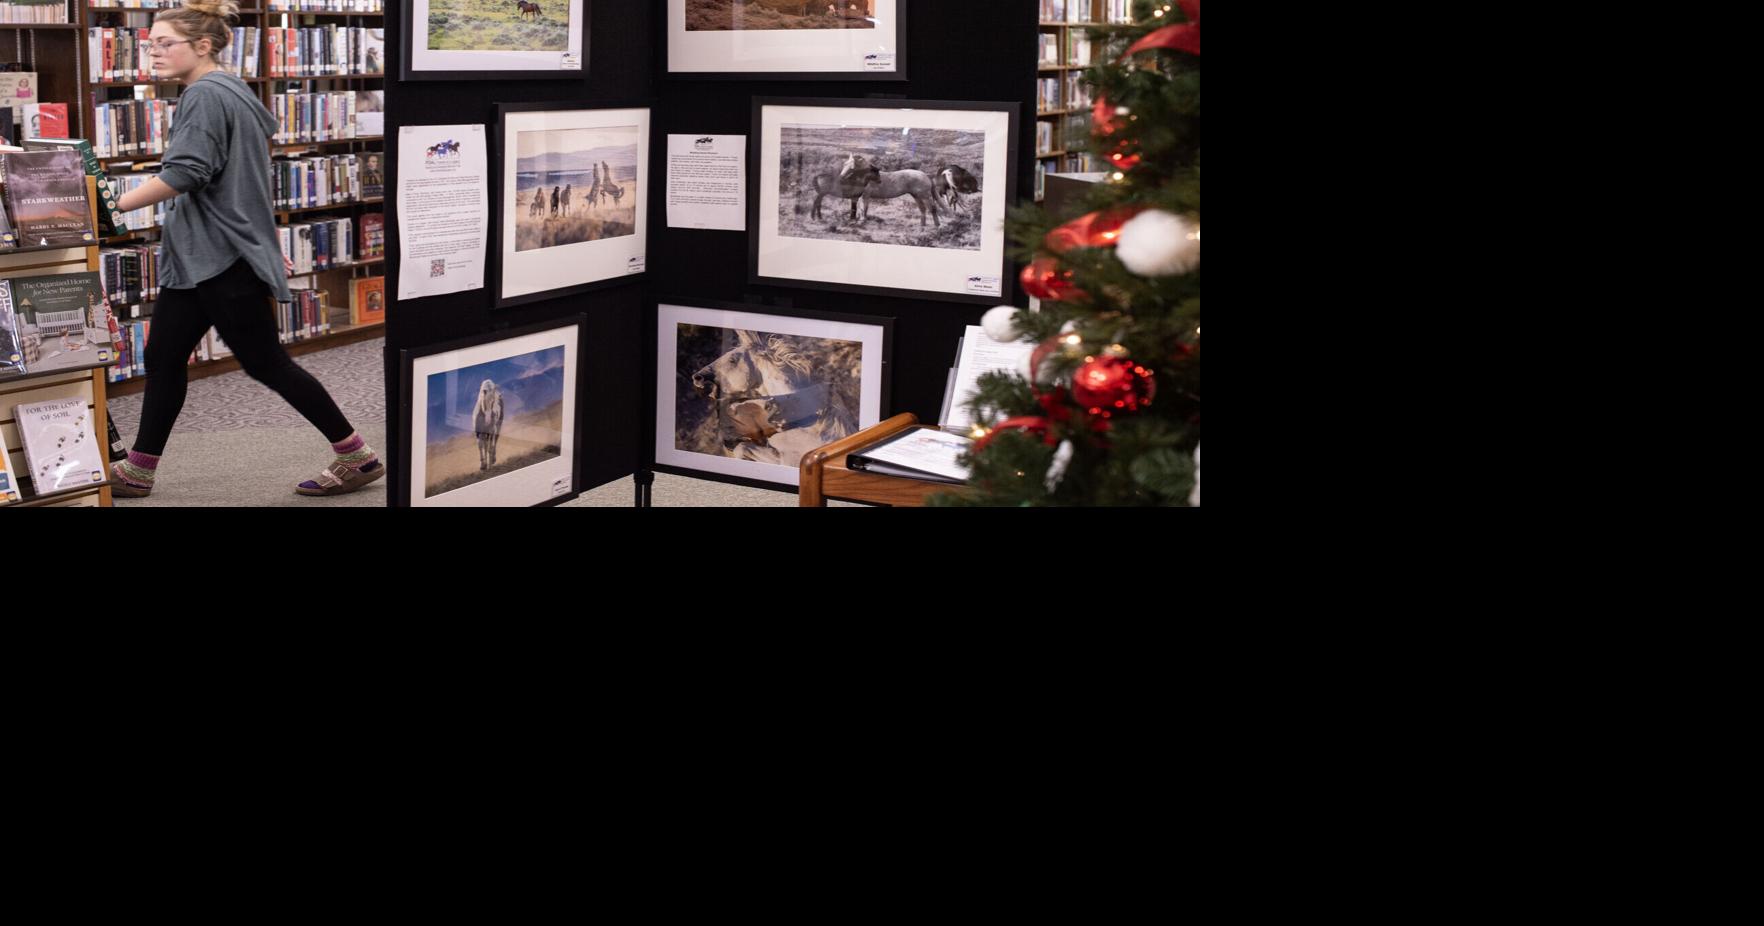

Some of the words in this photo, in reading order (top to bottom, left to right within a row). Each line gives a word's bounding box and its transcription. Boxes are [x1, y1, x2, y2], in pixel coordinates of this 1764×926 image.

[22, 195, 86, 204] STARKWEATHER
[22, 282, 34, 290] The
[36, 279, 71, 289] Organized
[33, 289, 42, 297] for
[43, 287, 58, 295] New
[60, 286, 84, 294] Parents
[26, 406, 42, 415] FOR
[43, 404, 59, 412] THE
[61, 401, 80, 410] LOVE
[40, 413, 51, 421] OF
[53, 411, 71, 419] SOIL
